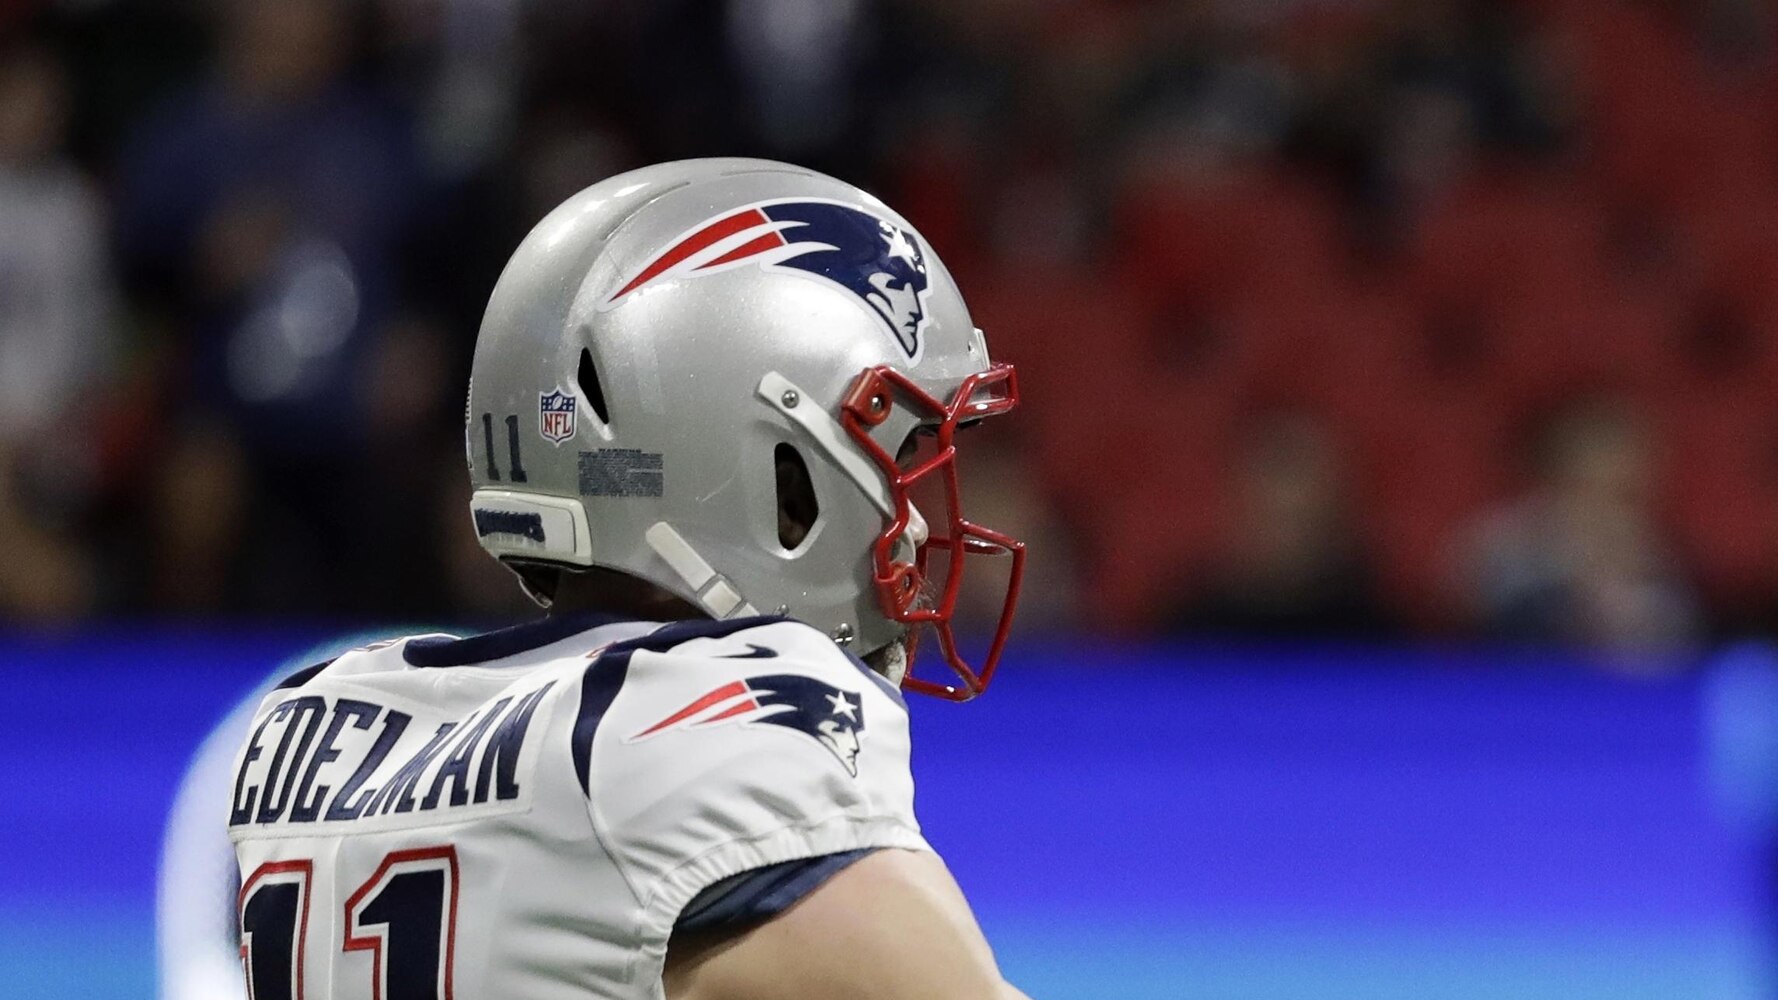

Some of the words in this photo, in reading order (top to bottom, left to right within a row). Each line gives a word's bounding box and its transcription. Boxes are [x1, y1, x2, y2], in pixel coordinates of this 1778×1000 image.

[482, 412, 527, 483] 11
[543, 413, 572, 436] NFL
[229, 681, 560, 827] EDELMAN
